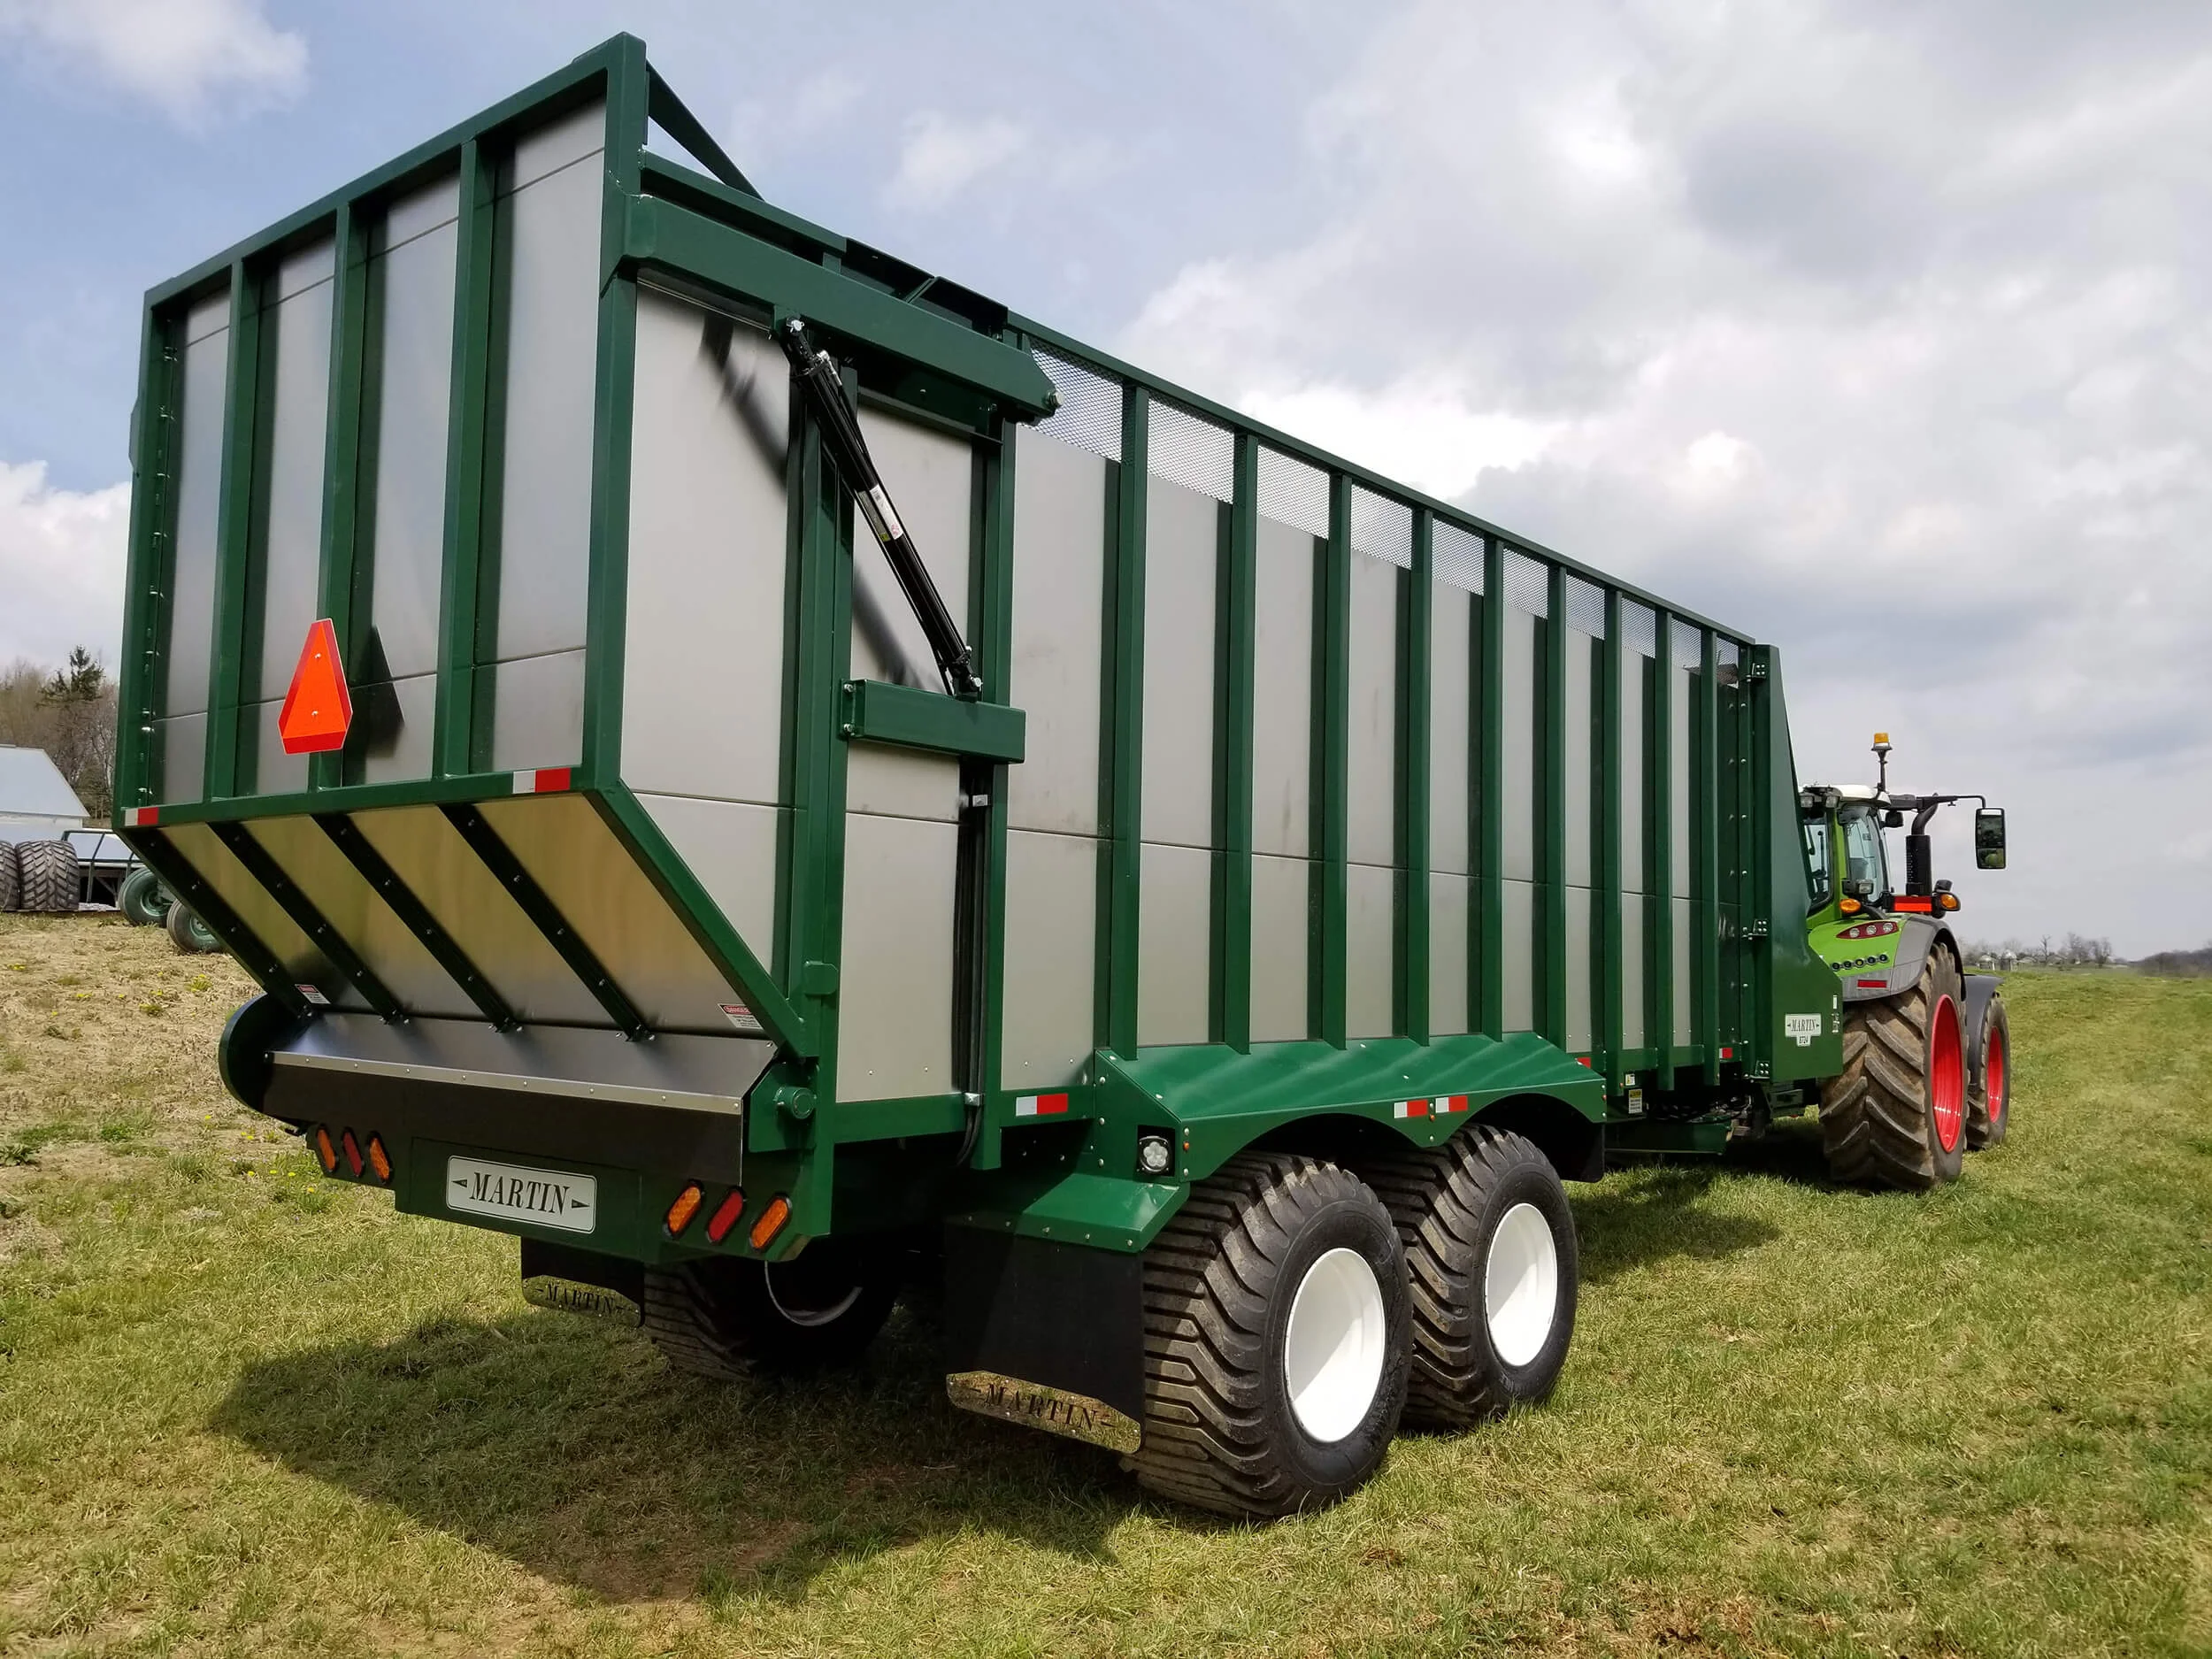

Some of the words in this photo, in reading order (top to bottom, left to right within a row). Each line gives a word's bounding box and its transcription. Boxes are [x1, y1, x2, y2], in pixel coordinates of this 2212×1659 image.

[1791, 1018, 1816, 1032] MARTIN
[469, 1171, 570, 1216] MARTIN
[545, 1282, 615, 1314] MARTIN
[984, 1383, 1100, 1431] MARTIN
